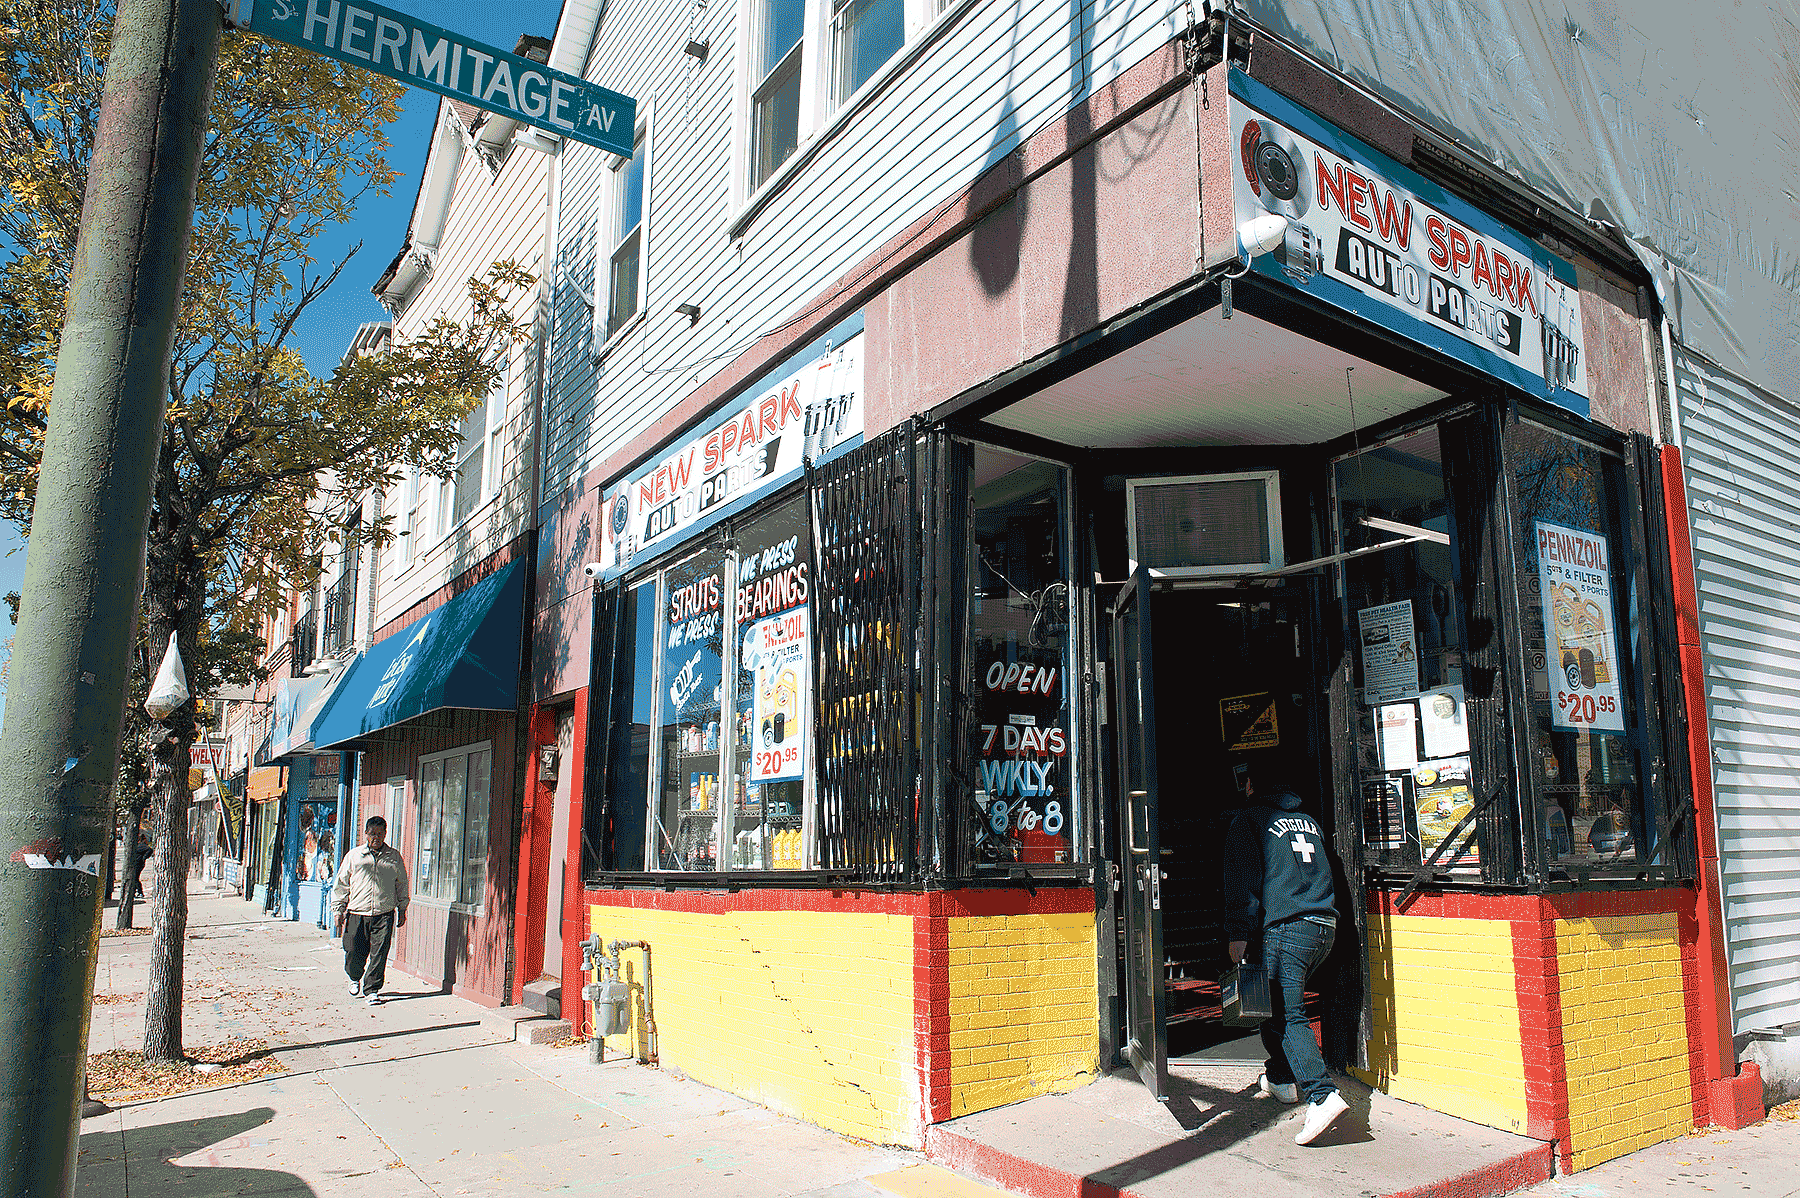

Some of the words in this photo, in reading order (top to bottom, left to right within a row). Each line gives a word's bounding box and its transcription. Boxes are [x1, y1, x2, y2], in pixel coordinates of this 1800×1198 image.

[271, 0, 298, 21] S
[303, 0, 577, 130] HERMITAGE
[586, 104, 616, 133] AV
[1314, 150, 1413, 253] NEW
[1425, 213, 1539, 320] SPARK
[1348, 236, 1421, 305] AUTO
[1431, 277, 1511, 347] PARTS
[638, 446, 696, 515] NEW
[703, 379, 802, 476] SPARK
[650, 492, 695, 537] AUTO
[701, 448, 768, 511] PARTS
[739, 552, 760, 584] WE
[760, 535, 798, 575] PRESS
[1538, 528, 1607, 572] PENNZOIL
[737, 562, 809, 624] BEARINGS
[1565, 569, 1572, 580] &
[1574, 570, 1603, 586] FILTER
[1587, 586, 1609, 597] PORTS
[671, 574, 719, 623] STRUTS
[668, 623, 684, 650] WE
[684, 611, 719, 646] PRESS
[985, 661, 1057, 697] OPEN
[1558, 690, 1616, 724] $20.95
[756, 747, 798, 775] $20.95
[981, 724, 998, 756] 7
[1003, 725, 1067, 757] DAYS
[979, 760, 1054, 797] WKLY.
[990, 801, 1009, 834] 8
[1017, 801, 1043, 831] to
[1043, 801, 1064, 836] 8
